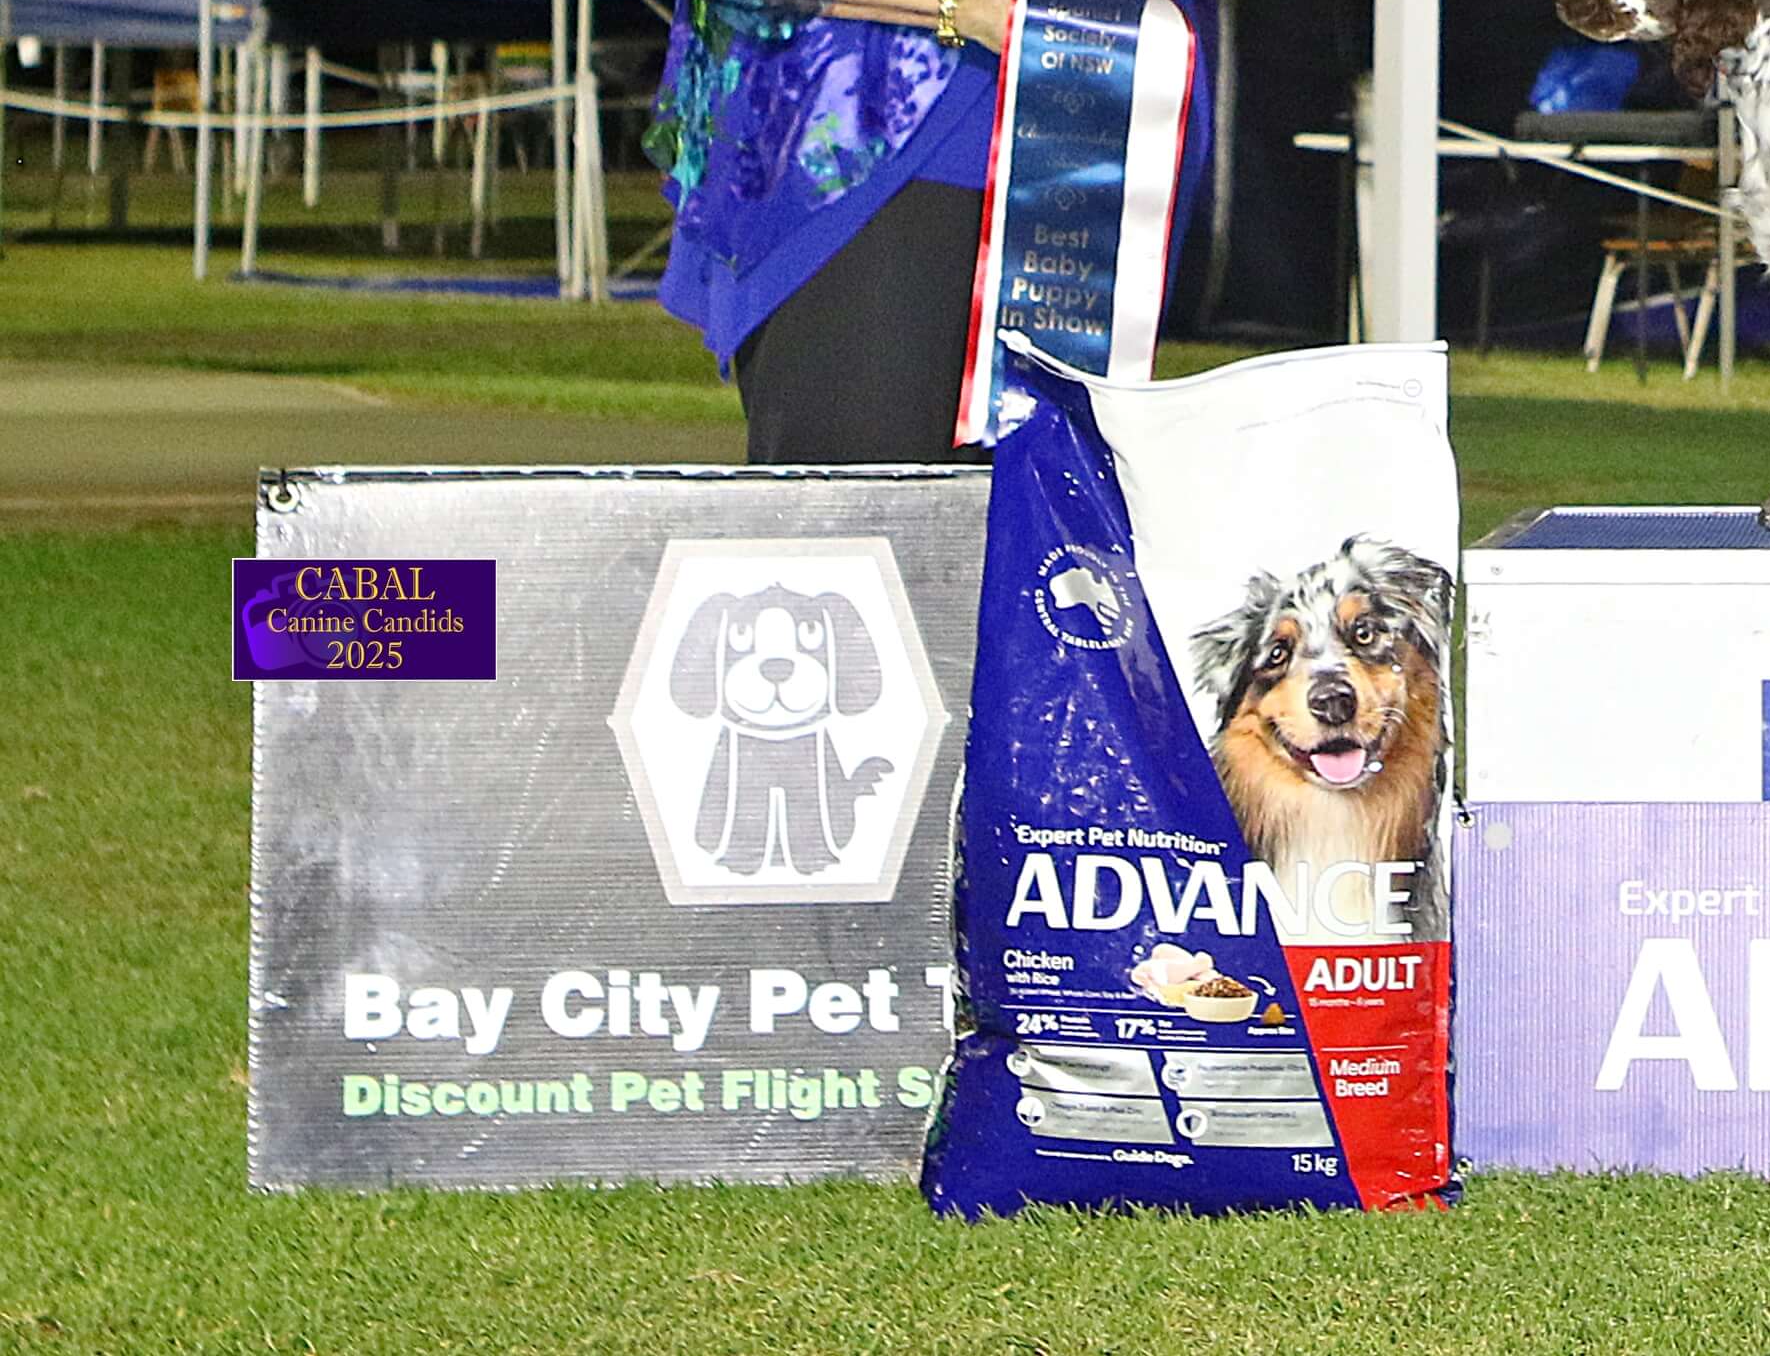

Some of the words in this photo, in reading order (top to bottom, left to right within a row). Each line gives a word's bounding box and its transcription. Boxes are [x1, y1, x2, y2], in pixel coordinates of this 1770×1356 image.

[1034, 224, 1090, 249] Best
[1023, 250, 1094, 282] Baby
[1011, 277, 1098, 311] Puppy
[1002, 305, 1024, 327] In
[1033, 307, 1105, 336] Show
[1017, 825, 1085, 848] Expert
[1088, 827, 1125, 847] Pet
[1618, 880, 1760, 924] Expert
[1003, 949, 1075, 971] Chicken
[1303, 955, 1423, 992] ADULT
[1006, 972, 1031, 984] with
[1031, 972, 1061, 986] Rice
[344, 973, 513, 1054] Bay
[540, 969, 720, 1052] City
[749, 968, 900, 1035] Pet
[1016, 1012, 1060, 1035] 24%
[1114, 1017, 1157, 1040] 17%
[1329, 1058, 1401, 1076] Medium
[342, 1073, 594, 1116] Discount
[611, 1070, 705, 1114] Pet
[721, 1067, 881, 1120] Flight
[1335, 1077, 1389, 1097] Breed
[1291, 1153, 1313, 1172] 15
[1314, 1153, 1339, 1177] kg
